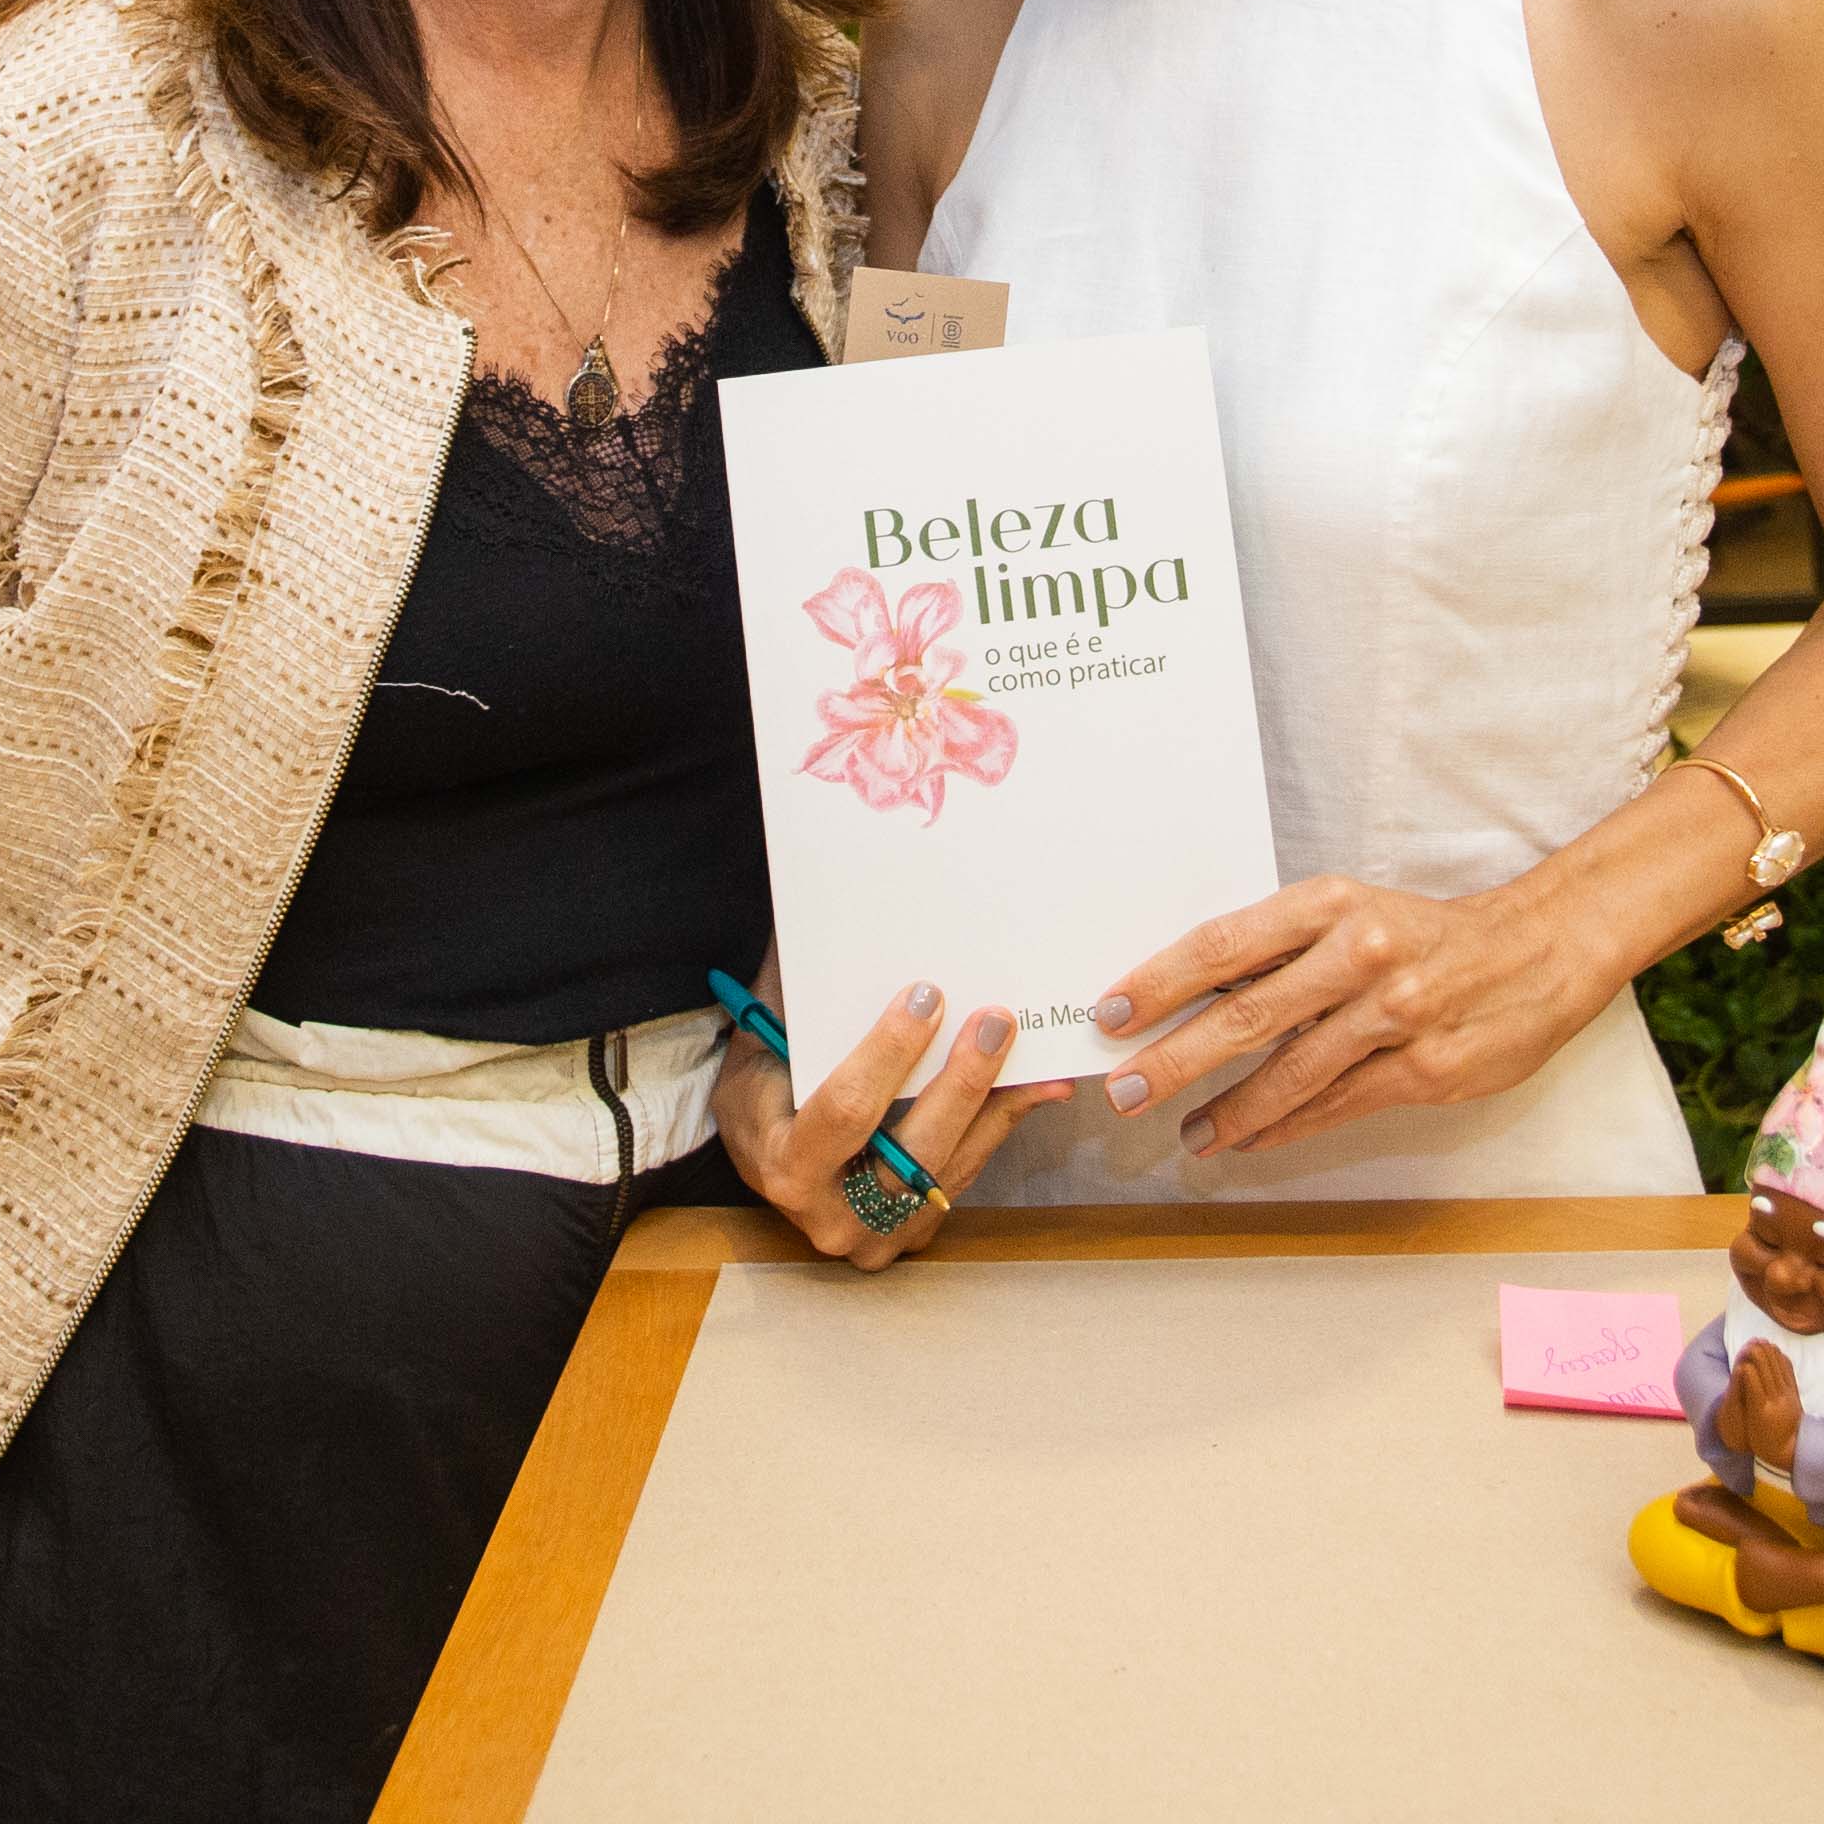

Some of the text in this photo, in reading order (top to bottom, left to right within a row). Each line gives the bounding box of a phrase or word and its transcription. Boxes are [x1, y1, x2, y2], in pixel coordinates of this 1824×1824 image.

[863, 497, 1119, 569] Beleza
[973, 557, 1189, 627] limpa
[984, 631, 1103, 668] o que é e
[987, 652, 1168, 693] como praticar
[1018, 1003, 1097, 1031] ila Mec
